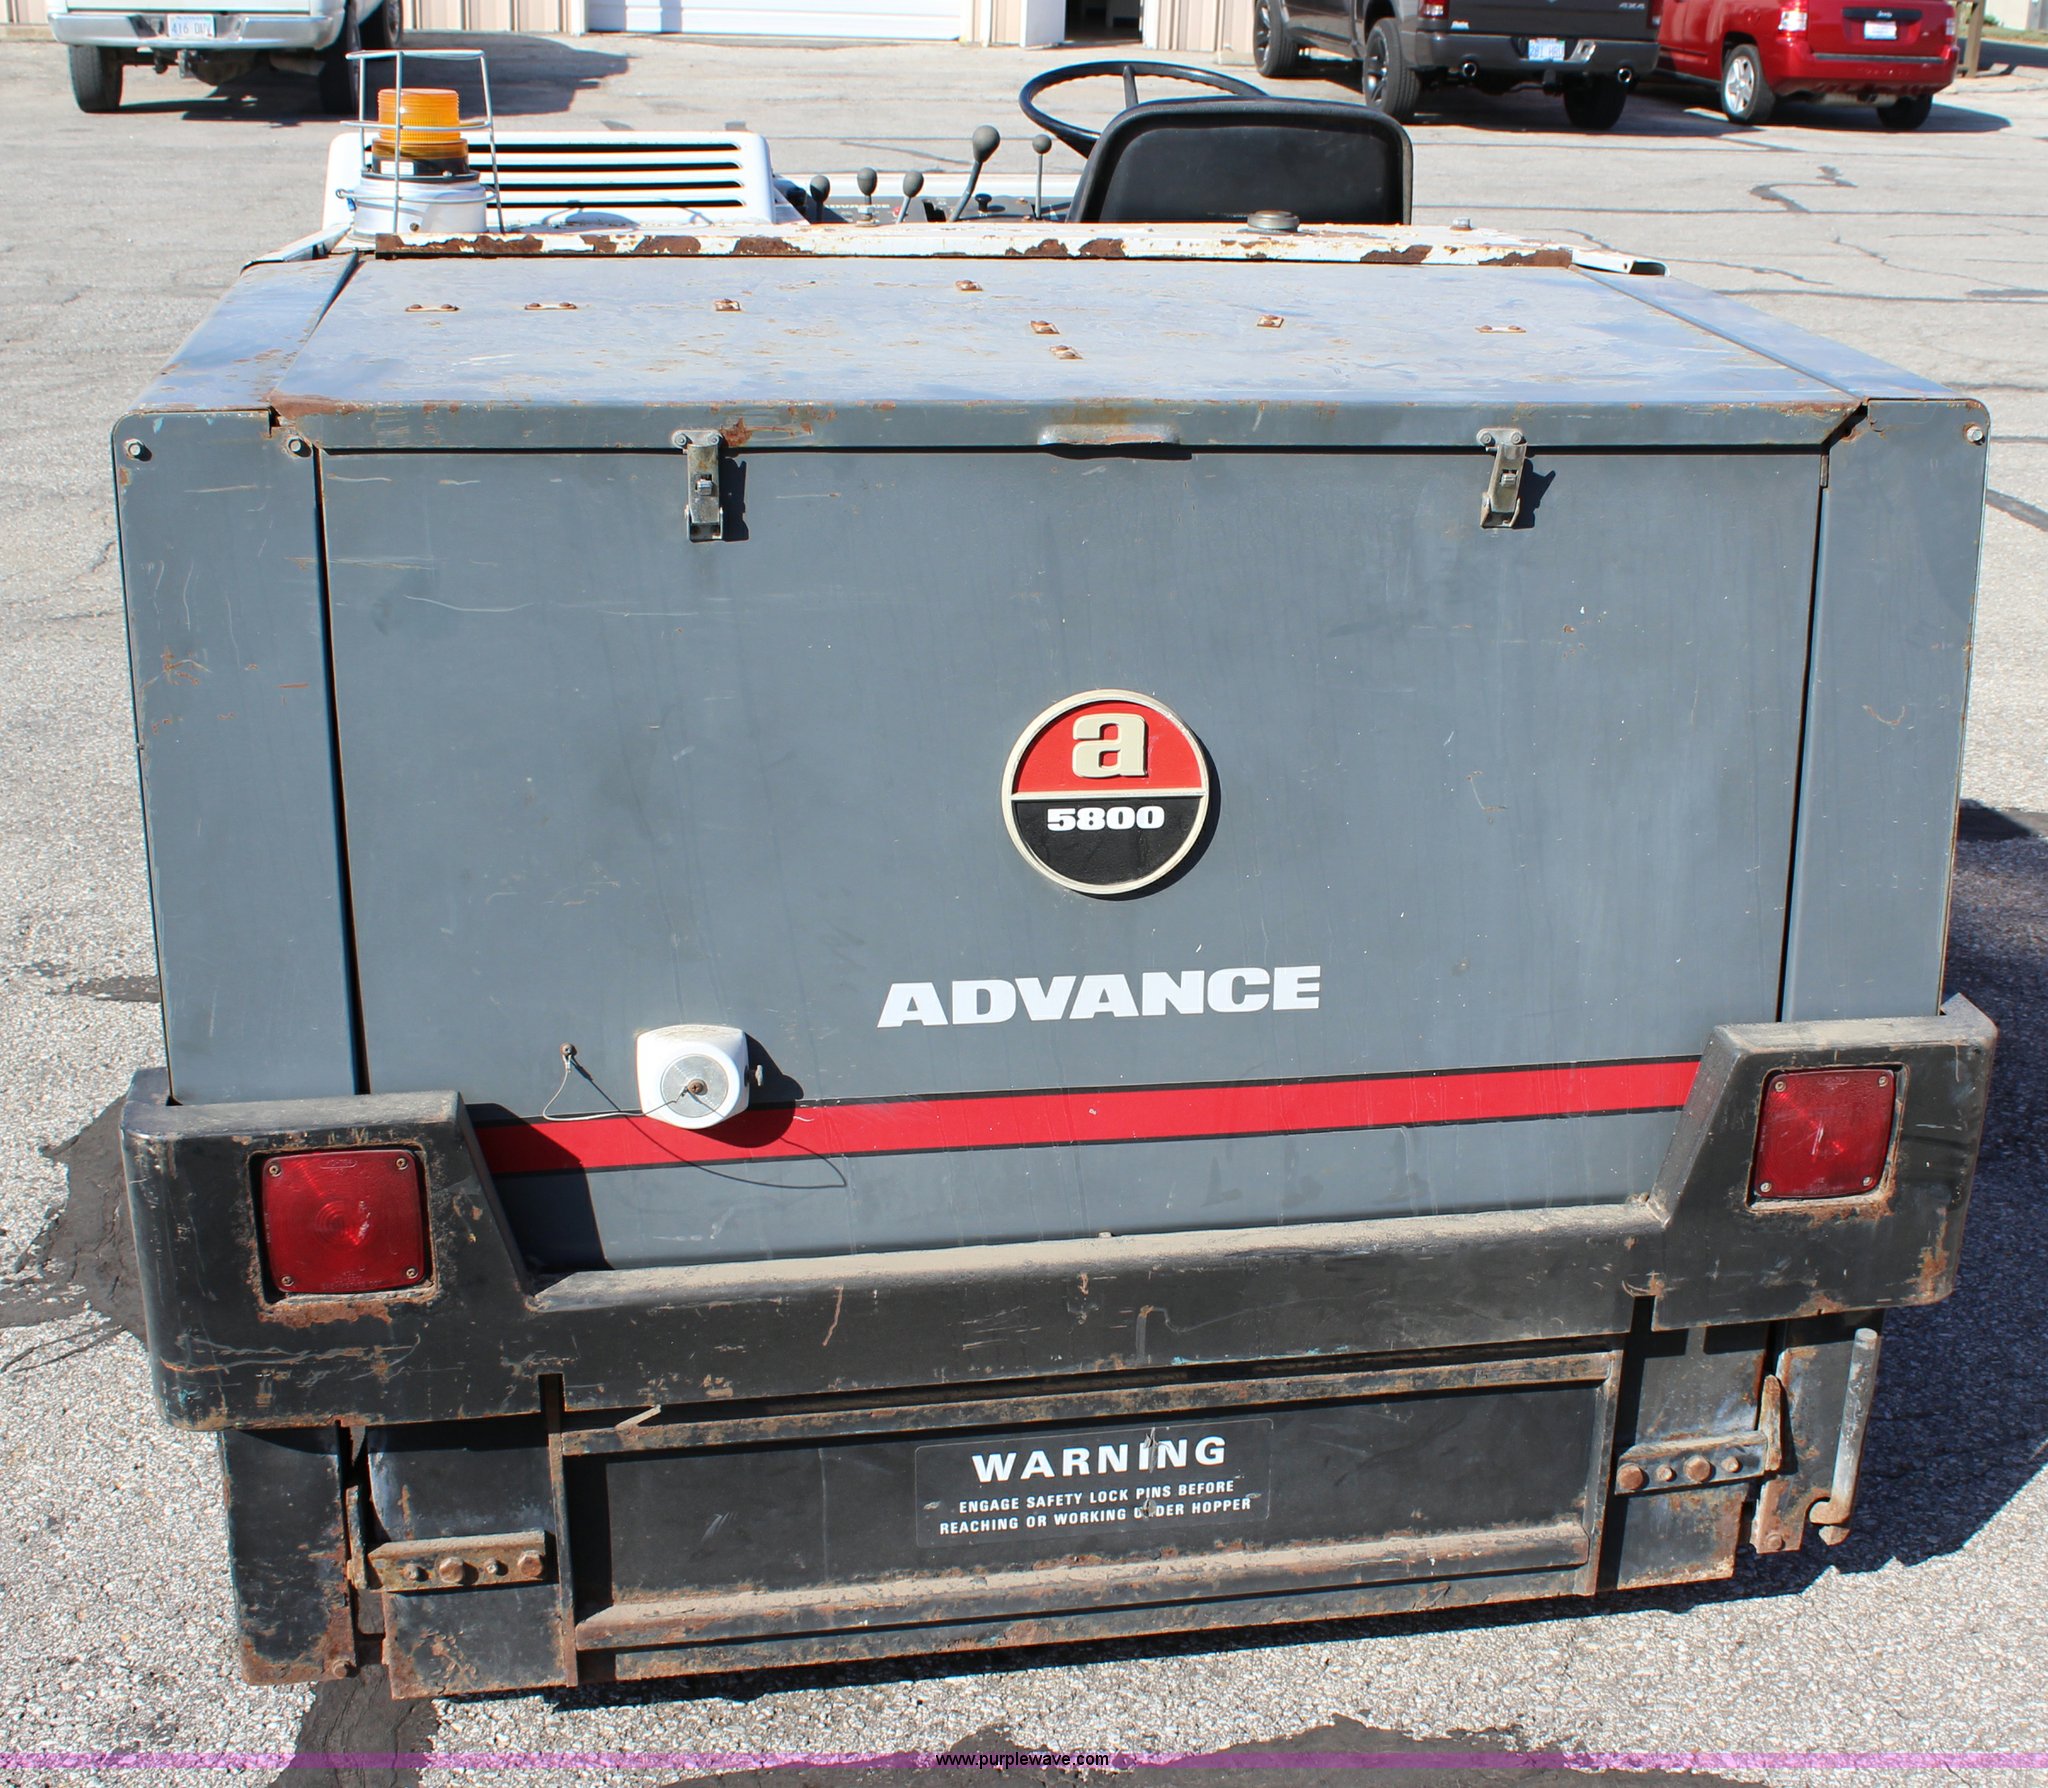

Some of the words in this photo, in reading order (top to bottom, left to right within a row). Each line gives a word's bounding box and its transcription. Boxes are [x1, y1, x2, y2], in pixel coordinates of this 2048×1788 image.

[1072, 712, 1147, 778] a
[1046, 805, 1165, 832] 5800
[877, 965, 1321, 1028] ADVANCE
[971, 1436, 1226, 1483] WARNING
[940, 1516, 1019, 1535] REACHING
[1026, 1514, 1047, 1528] OR
[1053, 1507, 1127, 1526] WORKING
[1133, 1503, 1185, 1520] UDER
[1191, 1497, 1252, 1514] HOPPER
[959, 1497, 1020, 1514] ENGAGE
[1026, 1492, 1083, 1509] SAFETY
[1089, 1487, 1129, 1503] LOCK
[1135, 1484, 1171, 1500] PINS
[1178, 1480, 1235, 1496] BEFORE
